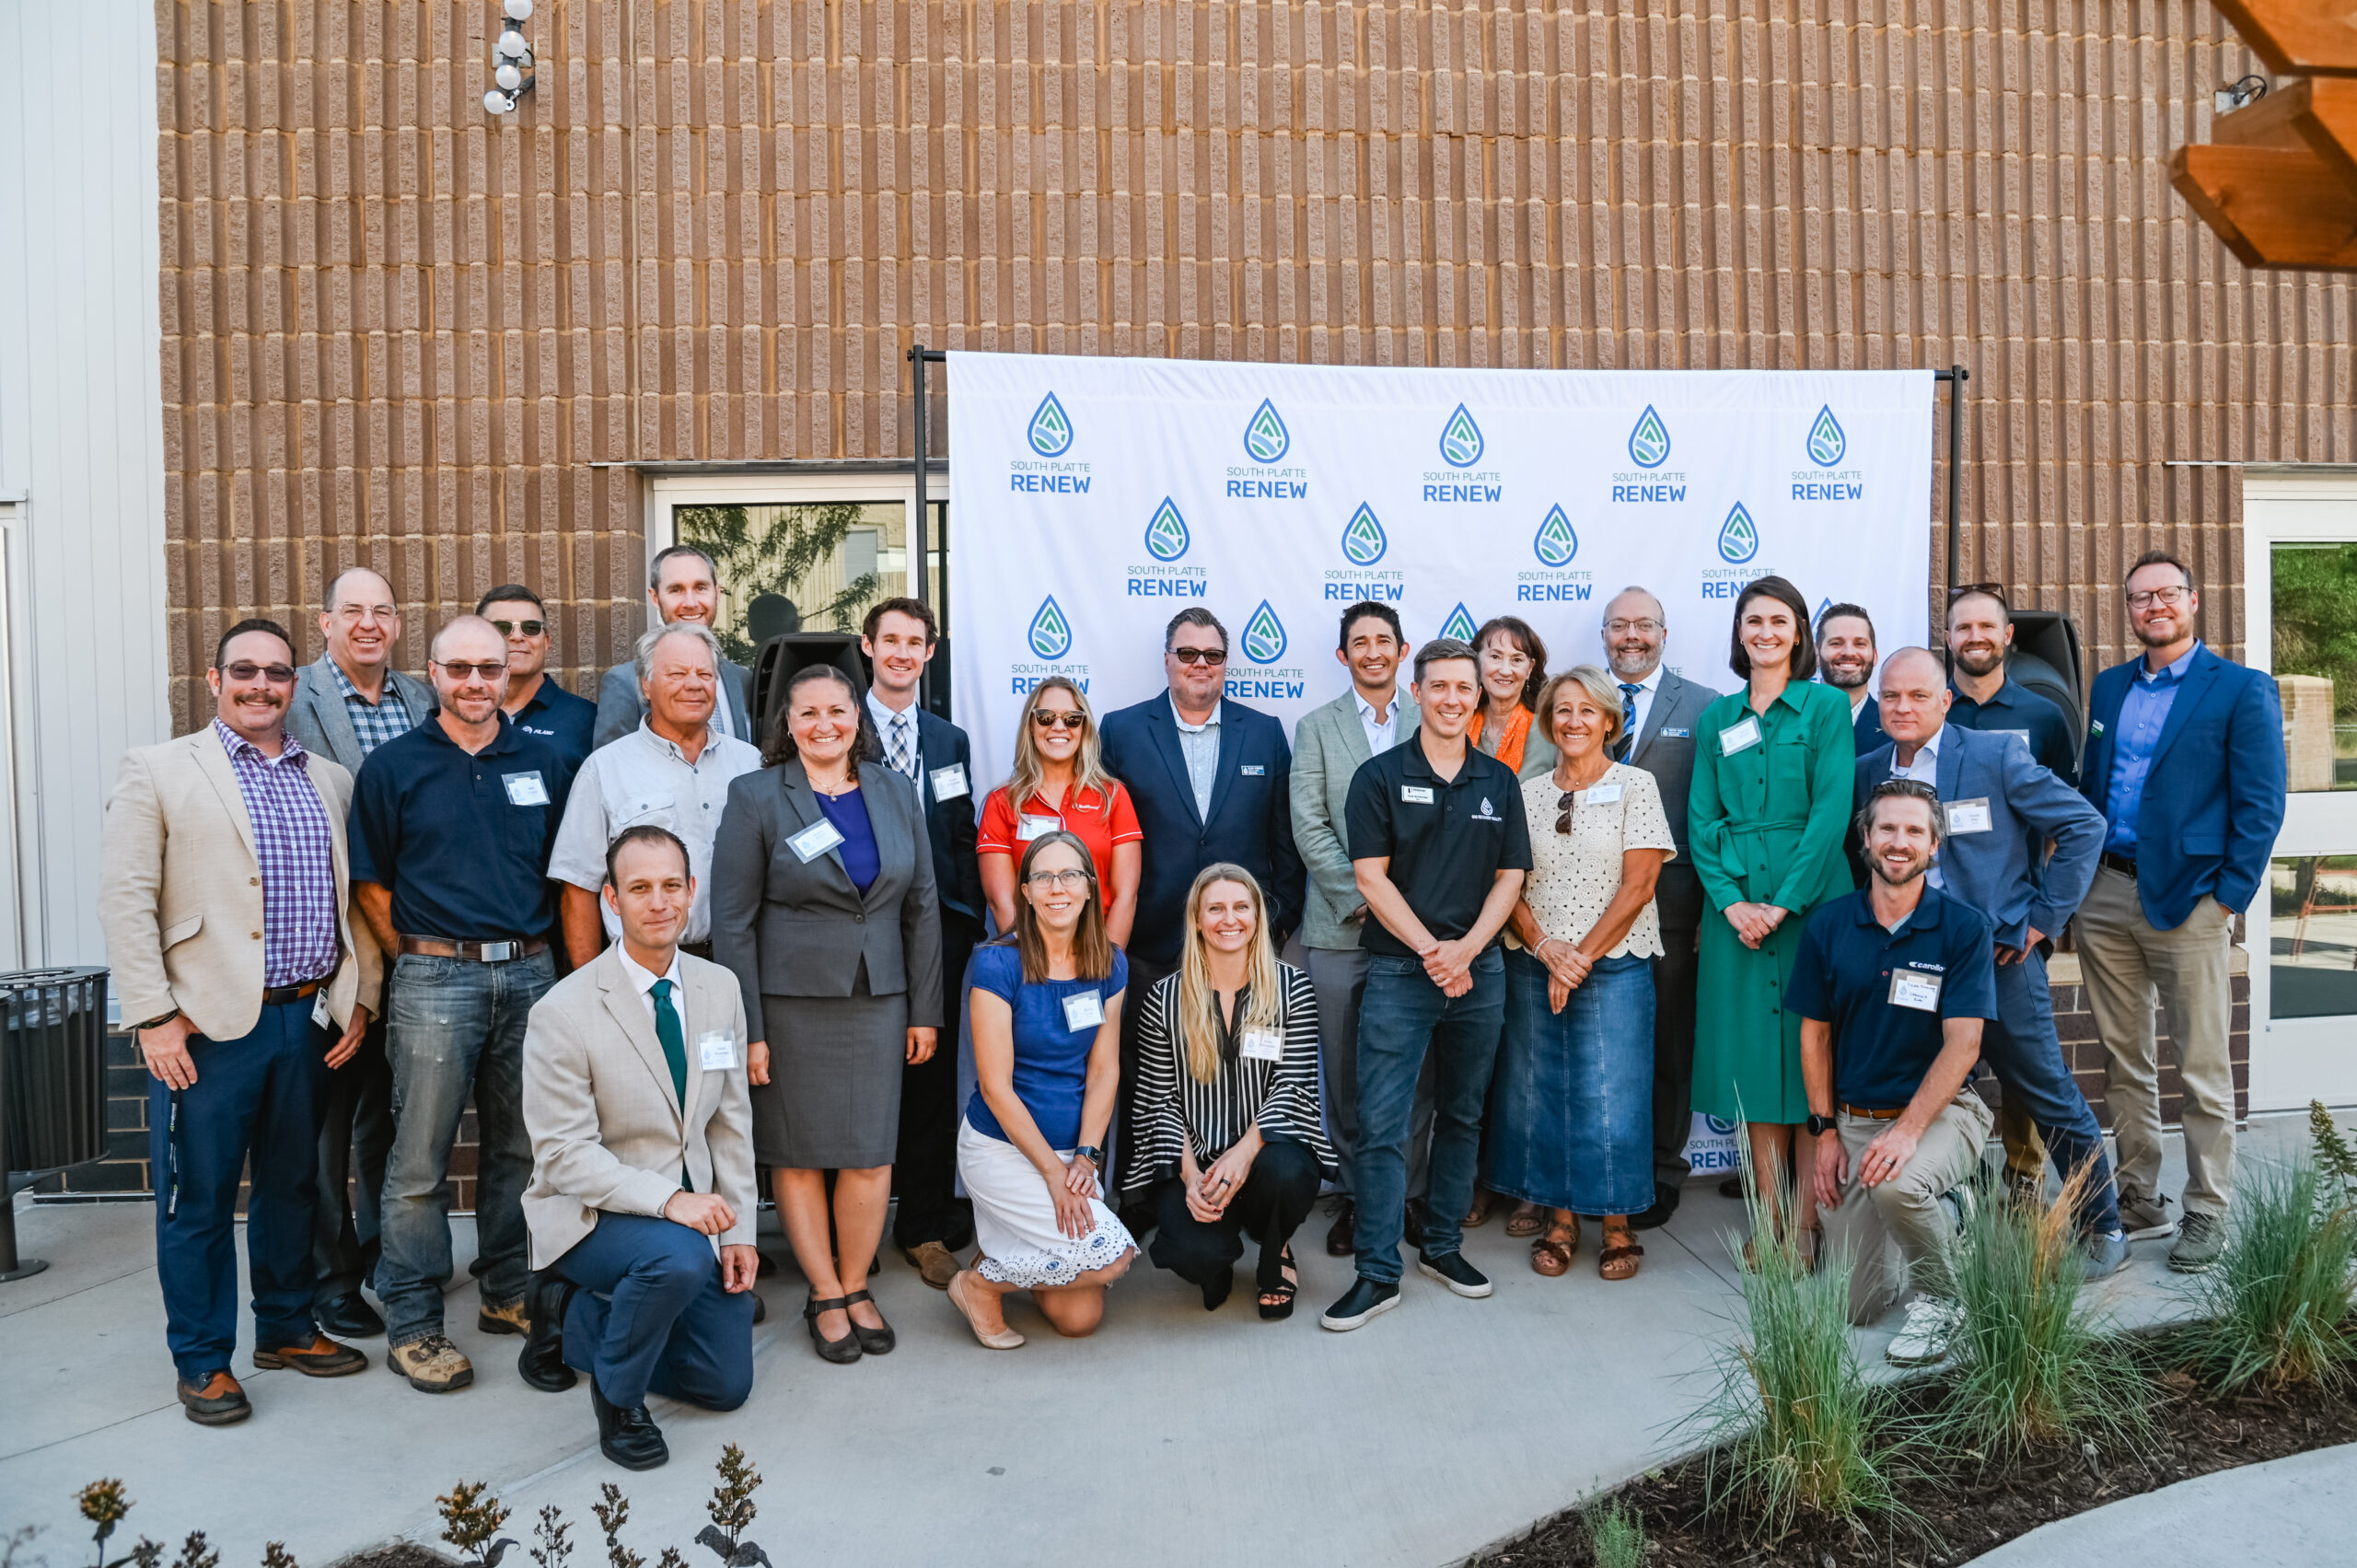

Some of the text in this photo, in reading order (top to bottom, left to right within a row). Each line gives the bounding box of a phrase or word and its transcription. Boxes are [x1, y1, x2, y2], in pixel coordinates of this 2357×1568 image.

[1010, 460, 1090, 472] SOUTH PLATTE
[1226, 467, 1307, 478] SOUTH PLATTE
[1422, 471, 1501, 482] SOUTH PLATTE
[1612, 472, 1687, 482] SOUTH PLATTE
[1791, 470, 1862, 480] SOUTH PLATTE
[1011, 474, 1091, 494] RENEW
[1226, 480, 1307, 499] RENEW
[1423, 484, 1502, 503] RENEW
[1612, 485, 1687, 502] RENEW
[1792, 483, 1863, 500] RENEW
[1127, 565, 1207, 576] SOUTH PLATTE
[1324, 570, 1404, 580] SOUTH PLATTE
[1517, 571, 1592, 581] SOUTH PLATTE
[1701, 568, 1775, 578] SOUTH PLATTE
[1128, 578, 1207, 598] RENEW
[1324, 583, 1404, 601] RENEW
[1517, 584, 1592, 601] RENEW
[1701, 581, 1753, 598] REN
[1011, 664, 1089, 675] SOUTH PLATTE
[1225, 668, 1304, 679] SOUTH PLATTE
[1224, 680, 1305, 699] RENEW
[1917, 962, 1945, 972] carollo
[1689, 1139, 1723, 1150] SOUTH
[1690, 1150, 1743, 1169] RENE
